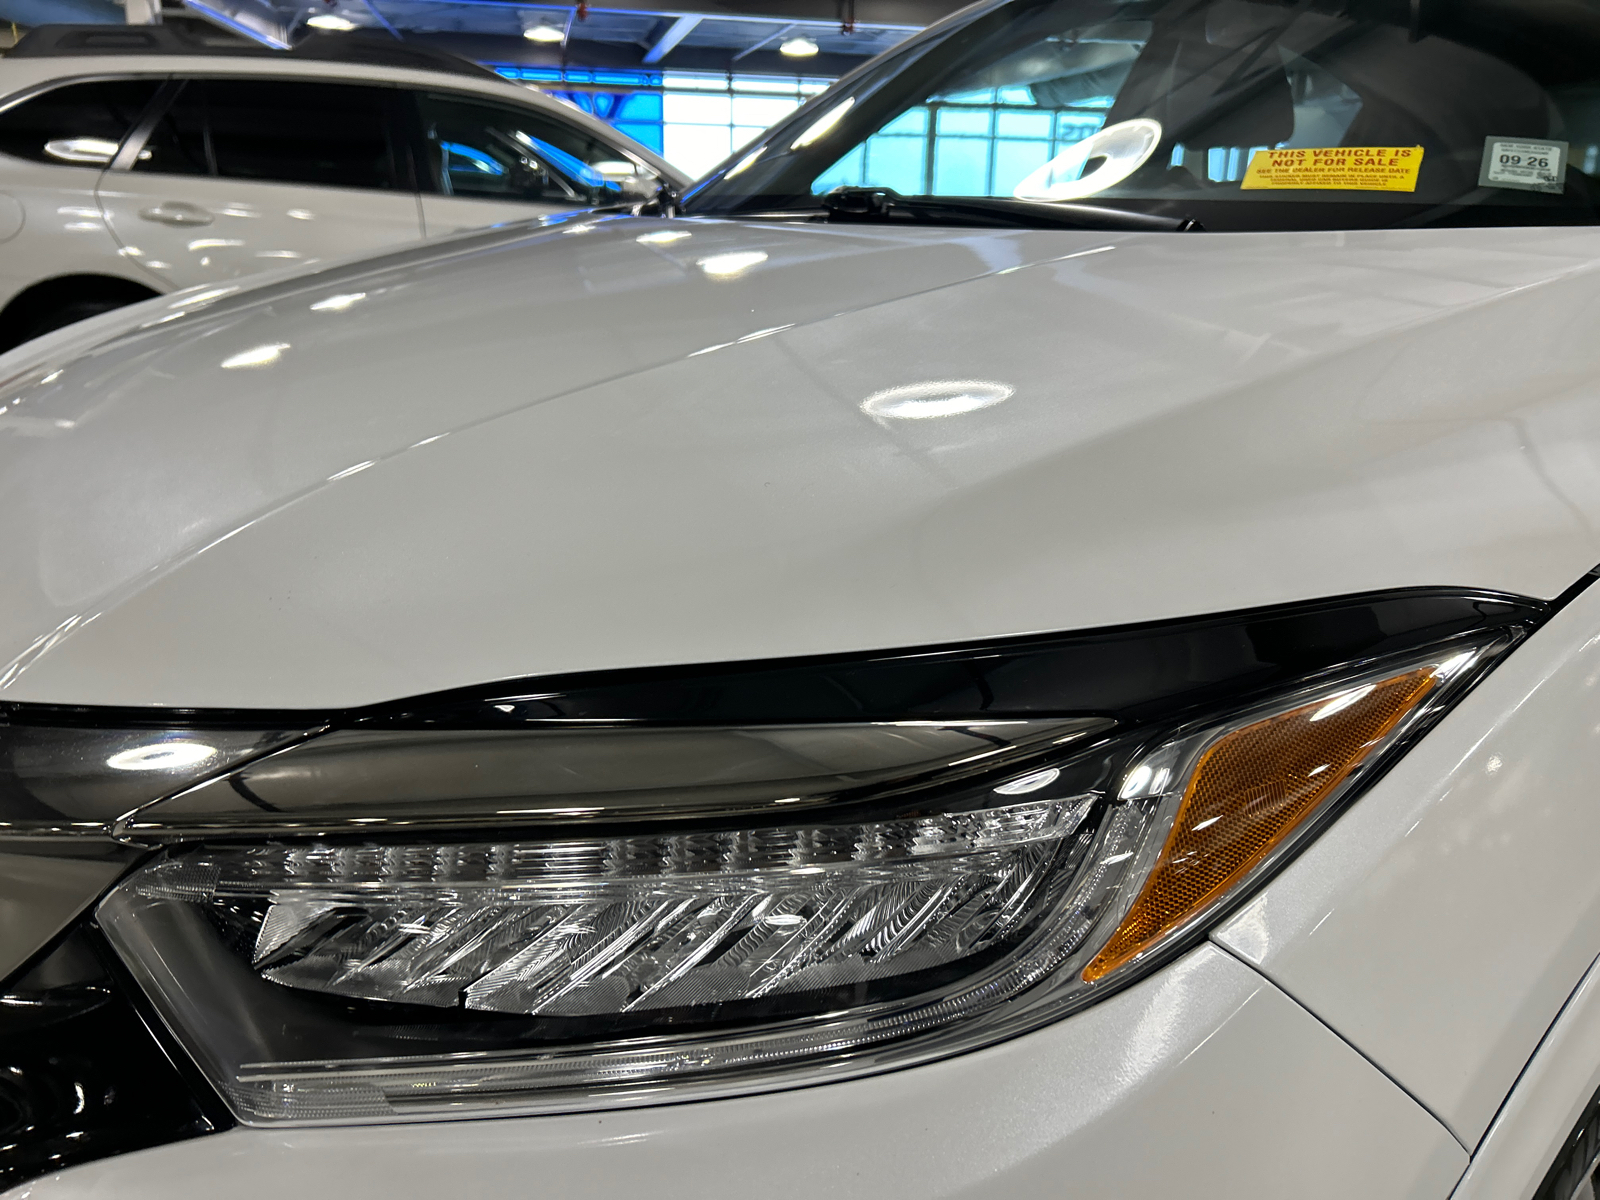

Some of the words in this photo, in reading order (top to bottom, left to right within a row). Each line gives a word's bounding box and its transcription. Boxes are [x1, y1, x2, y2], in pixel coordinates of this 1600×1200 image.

[1268, 150, 1306, 159] THIS
[1313, 149, 1387, 158] VEHICLE
[1394, 149, 1412, 157] IS
[1272, 159, 1307, 167] NOT
[1313, 158, 1346, 166] FOR
[1353, 158, 1399, 166] SALE
[1499, 154, 1521, 165] 09
[1527, 156, 1549, 168] 26
